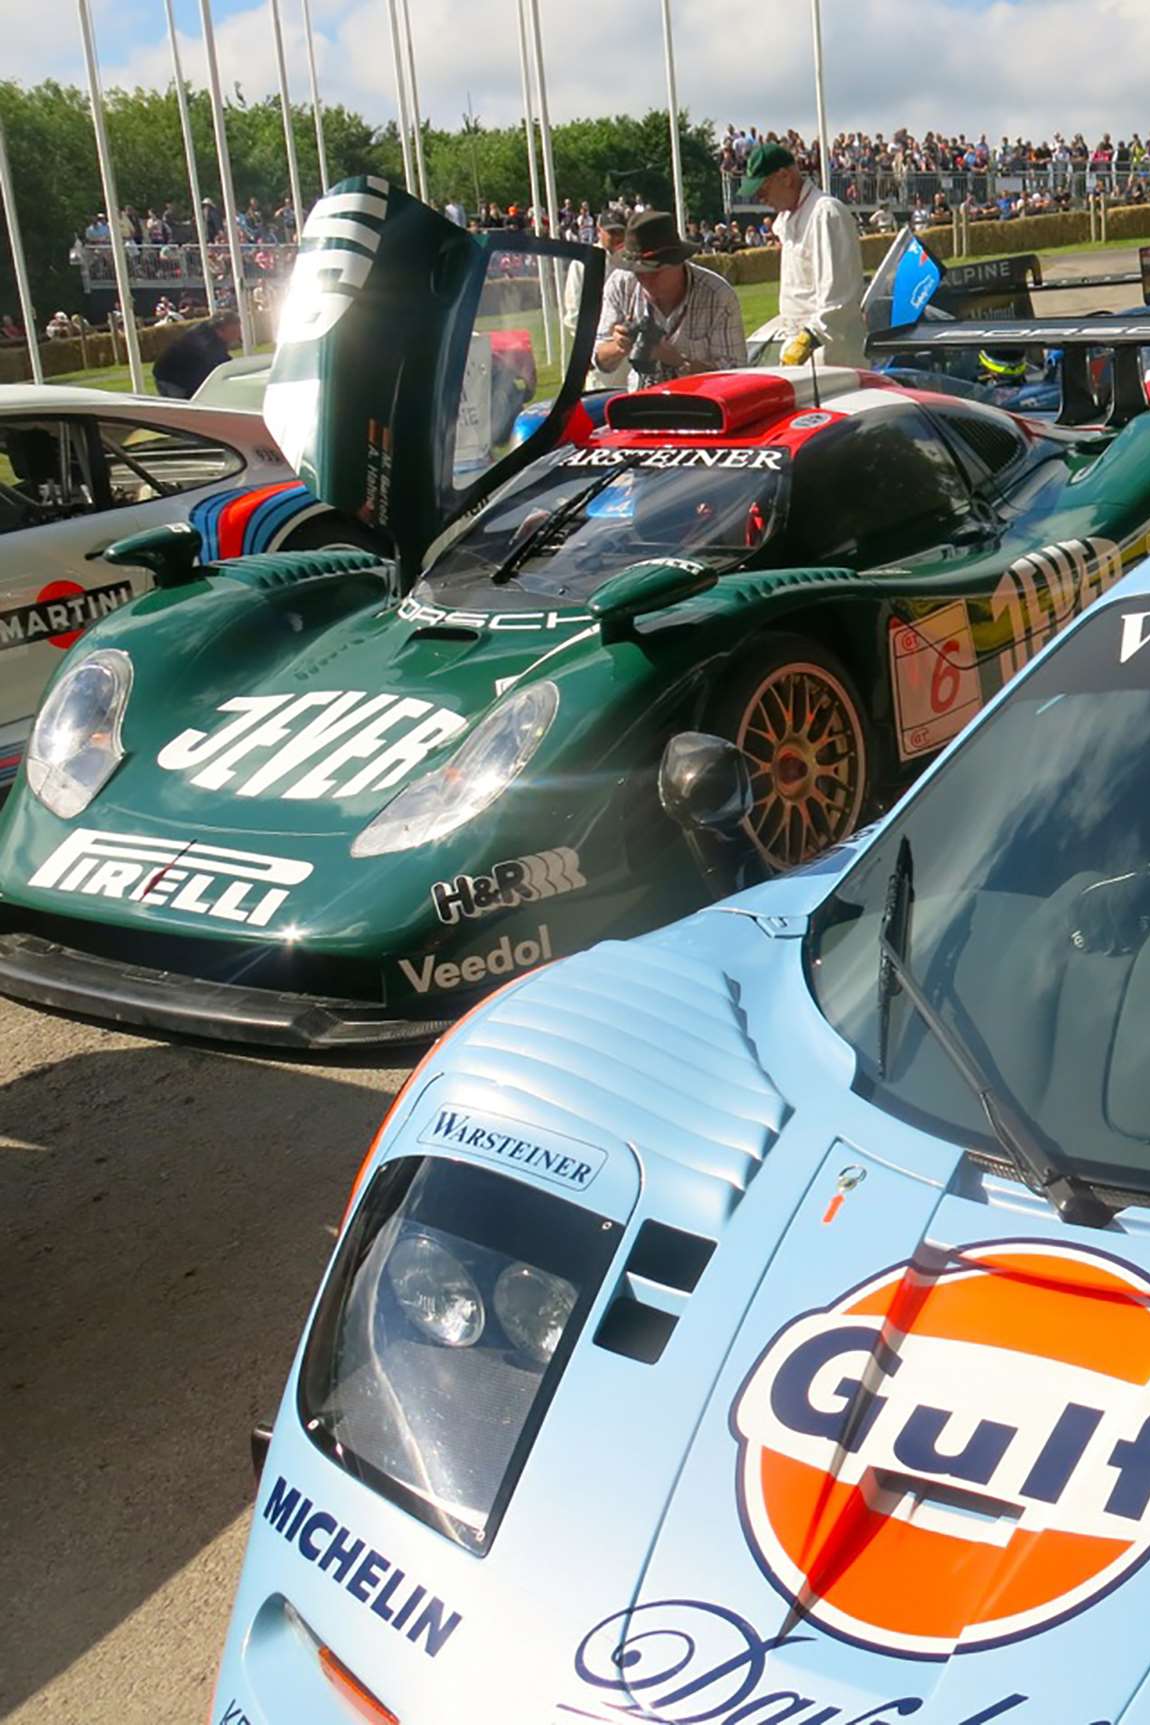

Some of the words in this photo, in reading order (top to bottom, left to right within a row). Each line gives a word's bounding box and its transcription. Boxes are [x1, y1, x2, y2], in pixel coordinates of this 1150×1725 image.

[941, 261, 1011, 286] ALPINE
[559, 448, 783, 471] ARSTEINER
[0, 587, 130, 643] MARTINI
[930, 639, 960, 715] 6
[157, 690, 468, 800] JEVER
[27, 828, 314, 927] PIRELLI
[431, 852, 562, 924] H&R
[398, 923, 553, 993] Veedol
[432, 1110, 593, 1186] WARSTEINER
[261, 1475, 463, 1658] MICHELIN
